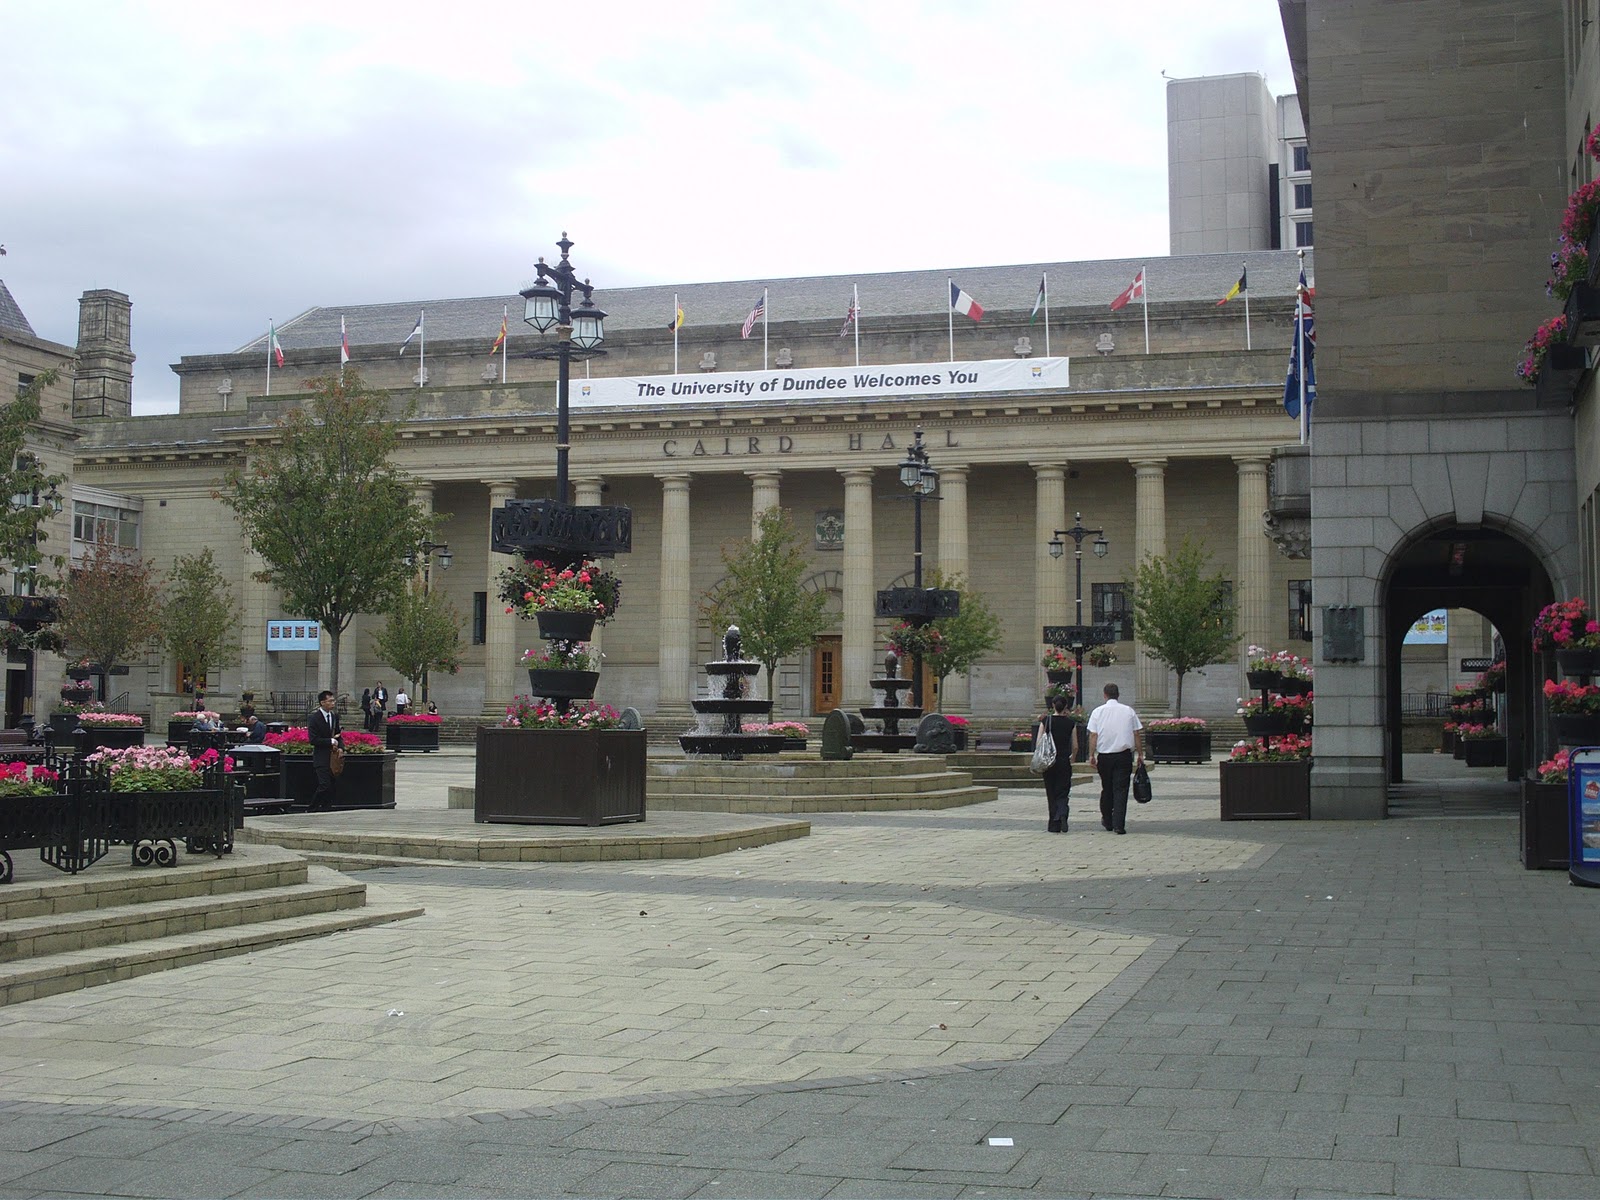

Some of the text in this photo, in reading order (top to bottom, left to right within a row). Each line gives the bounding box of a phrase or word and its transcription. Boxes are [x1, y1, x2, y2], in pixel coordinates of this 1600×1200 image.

[637, 371, 979, 397] The University of Dundee Welcomes You
[663, 430, 959, 457] CAIRD HAL
